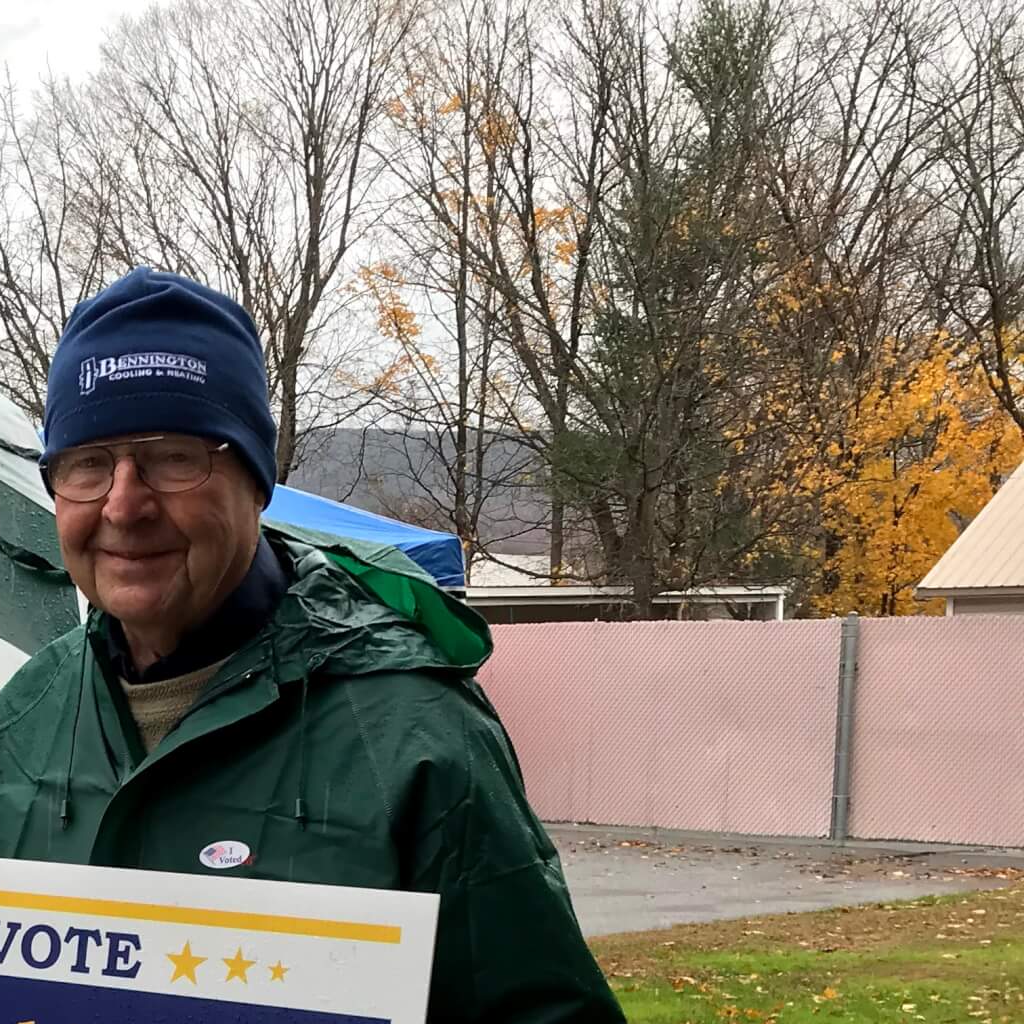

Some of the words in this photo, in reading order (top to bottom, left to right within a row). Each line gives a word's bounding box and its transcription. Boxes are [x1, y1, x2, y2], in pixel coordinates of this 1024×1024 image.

[97, 353, 208, 379] BENNINGTON
[108, 368, 153, 382] COOLING
[166, 369, 206, 385] HEATING
[219, 855, 242, 864] Voted
